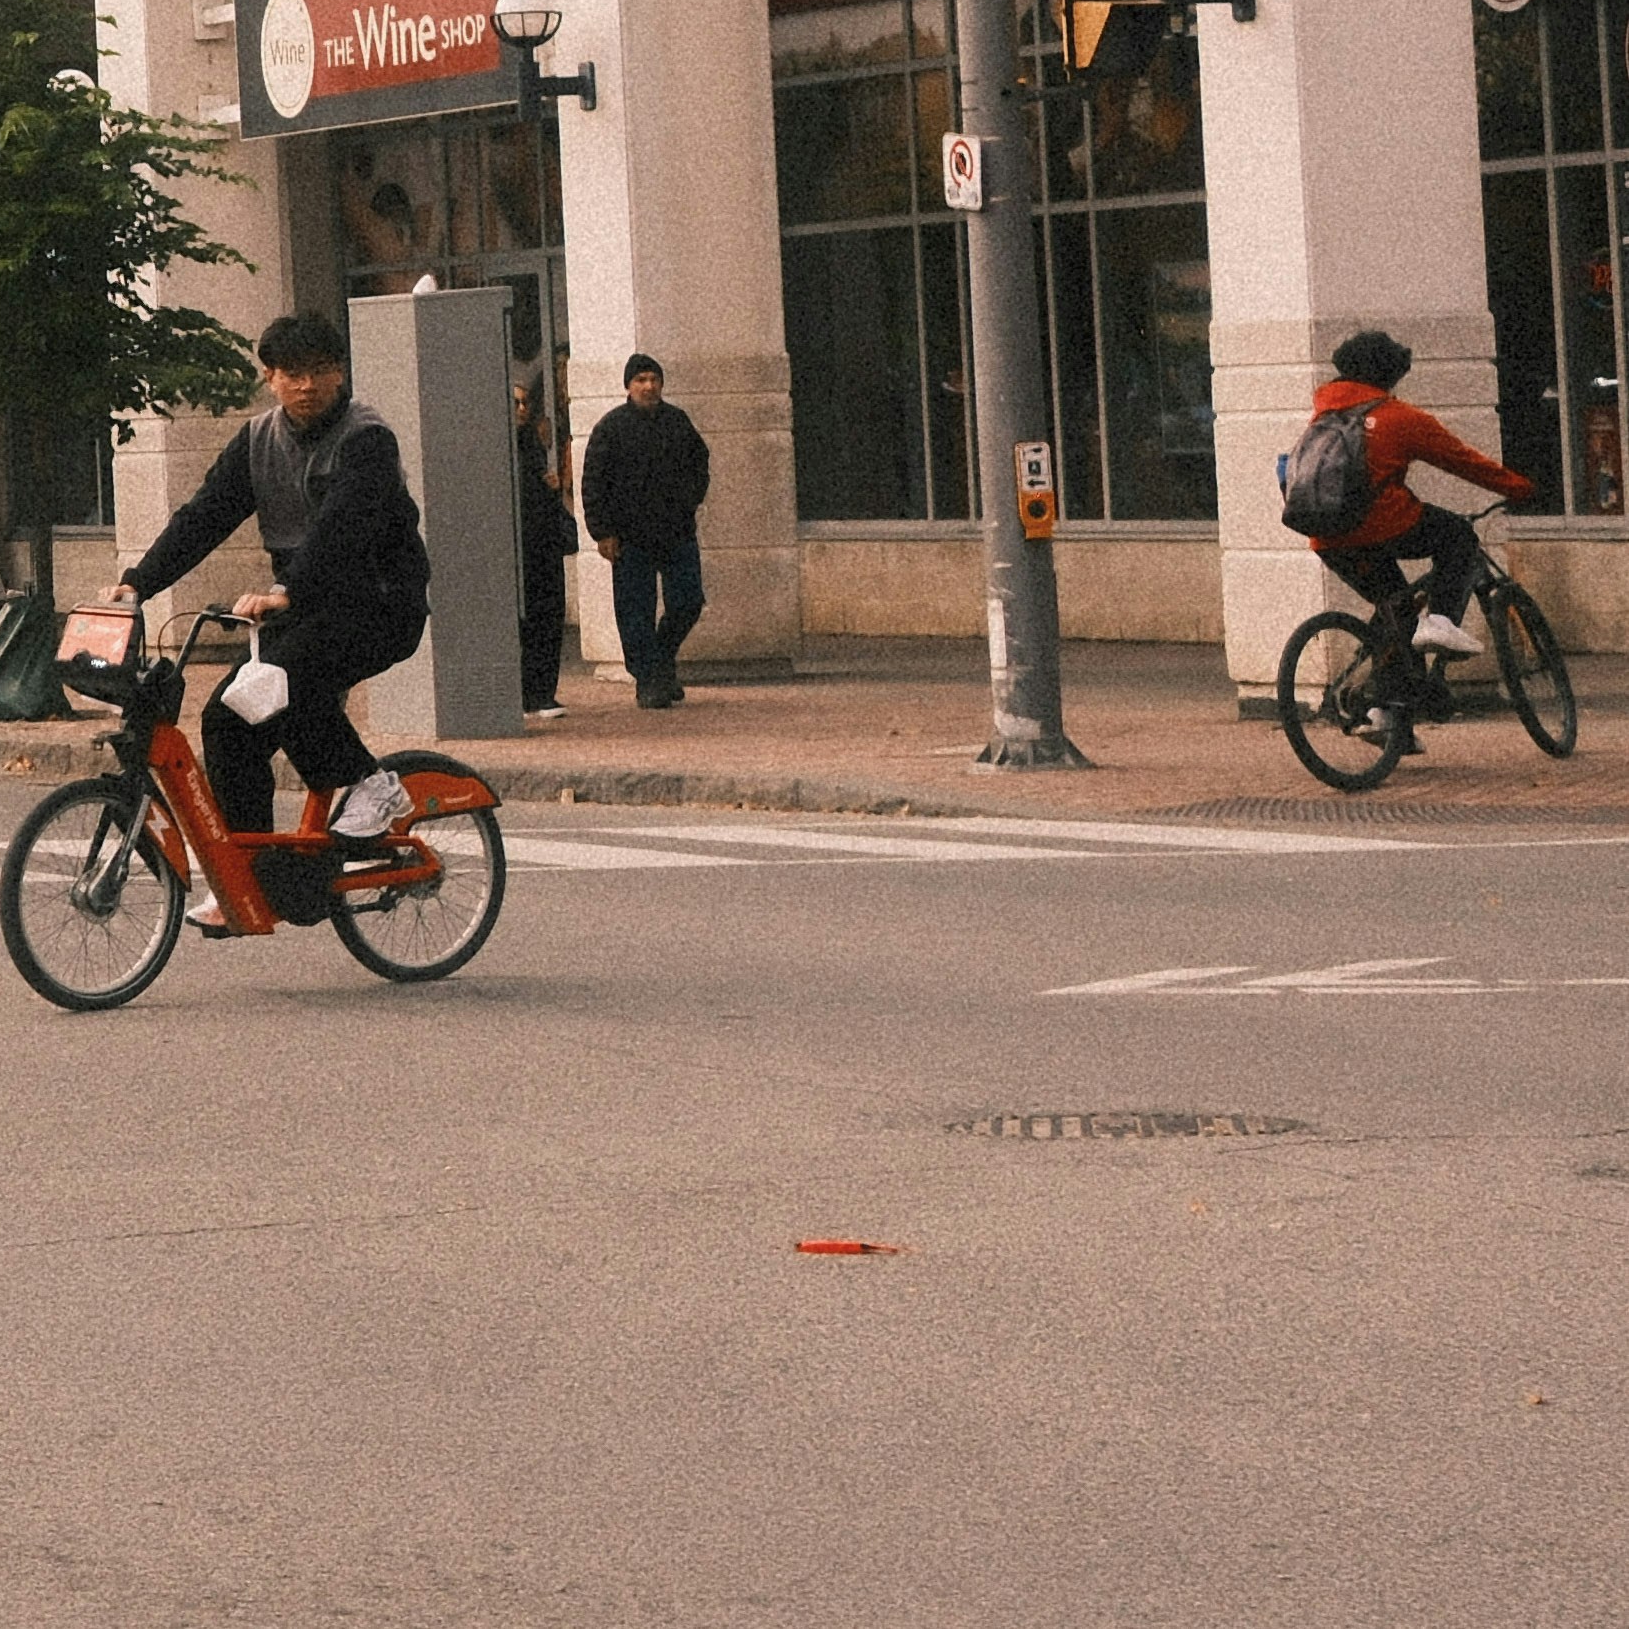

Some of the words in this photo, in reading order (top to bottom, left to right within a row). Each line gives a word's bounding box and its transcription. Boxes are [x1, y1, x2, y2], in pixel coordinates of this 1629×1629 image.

[270, 40, 306, 66] Wine
[323, 36, 355, 68] THE
[353, 3, 436, 71] Wine
[440, 14, 486, 50] SHOP
